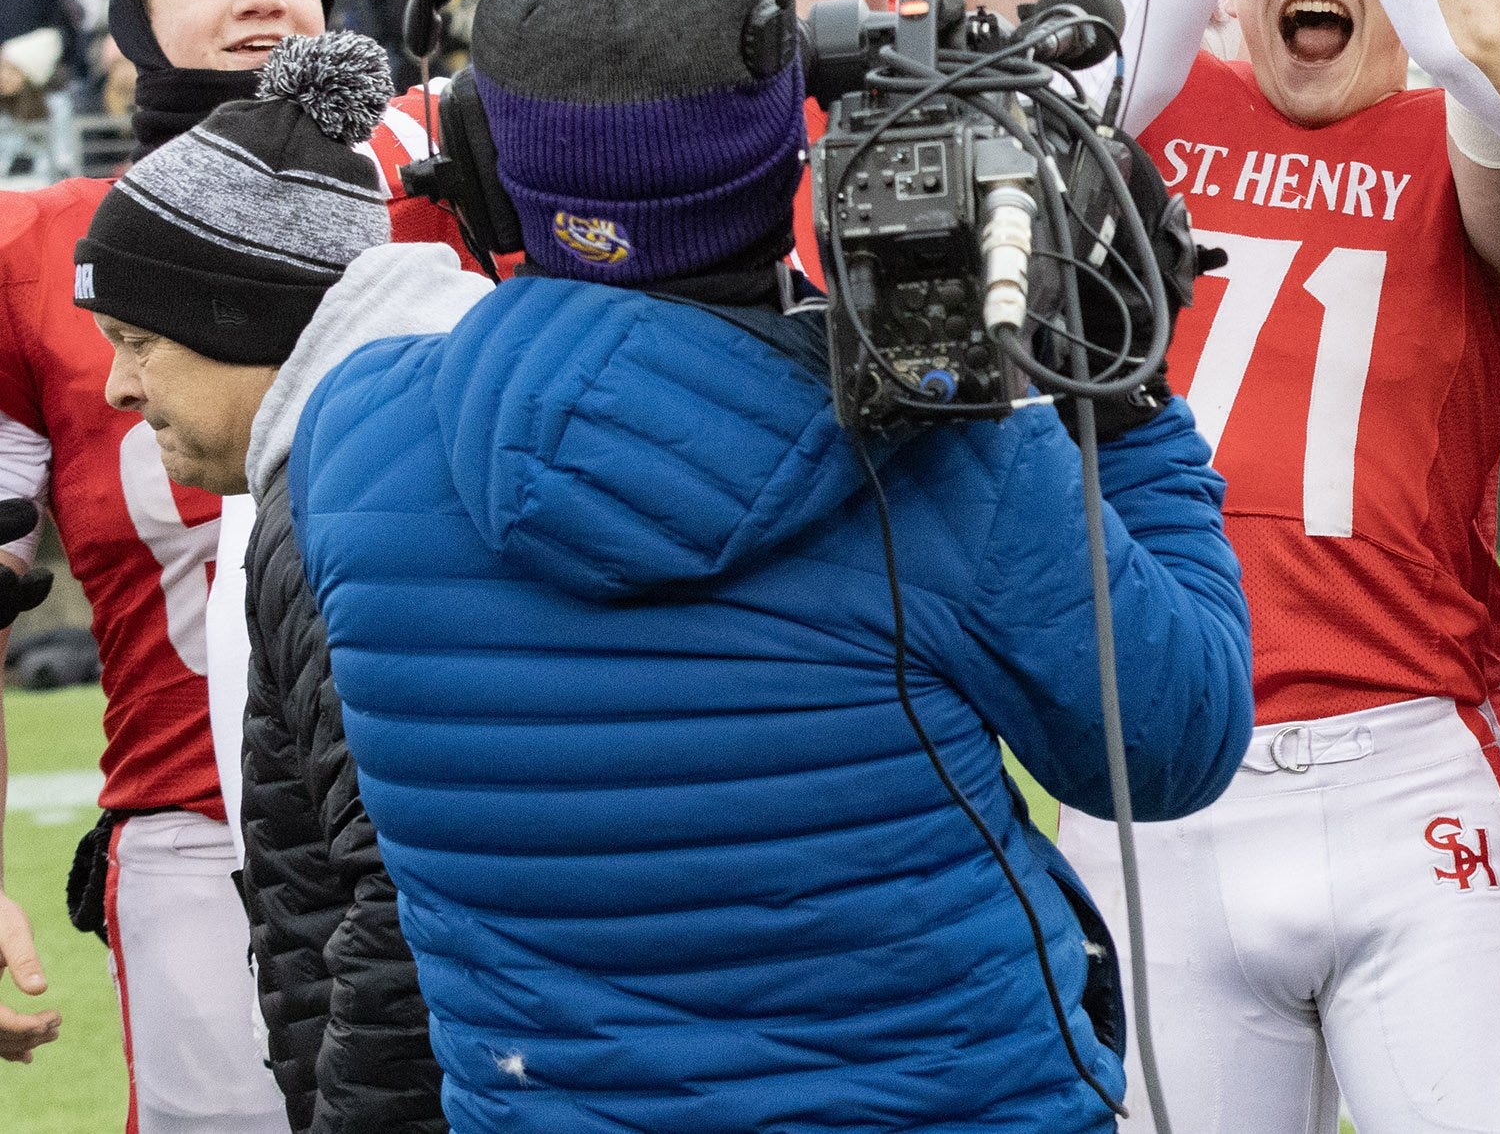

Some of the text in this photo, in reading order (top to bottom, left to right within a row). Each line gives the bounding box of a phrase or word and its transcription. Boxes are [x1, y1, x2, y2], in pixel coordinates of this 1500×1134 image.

[1161, 138, 1412, 221] ST. HENRY
[1187, 228, 1388, 538] 71
